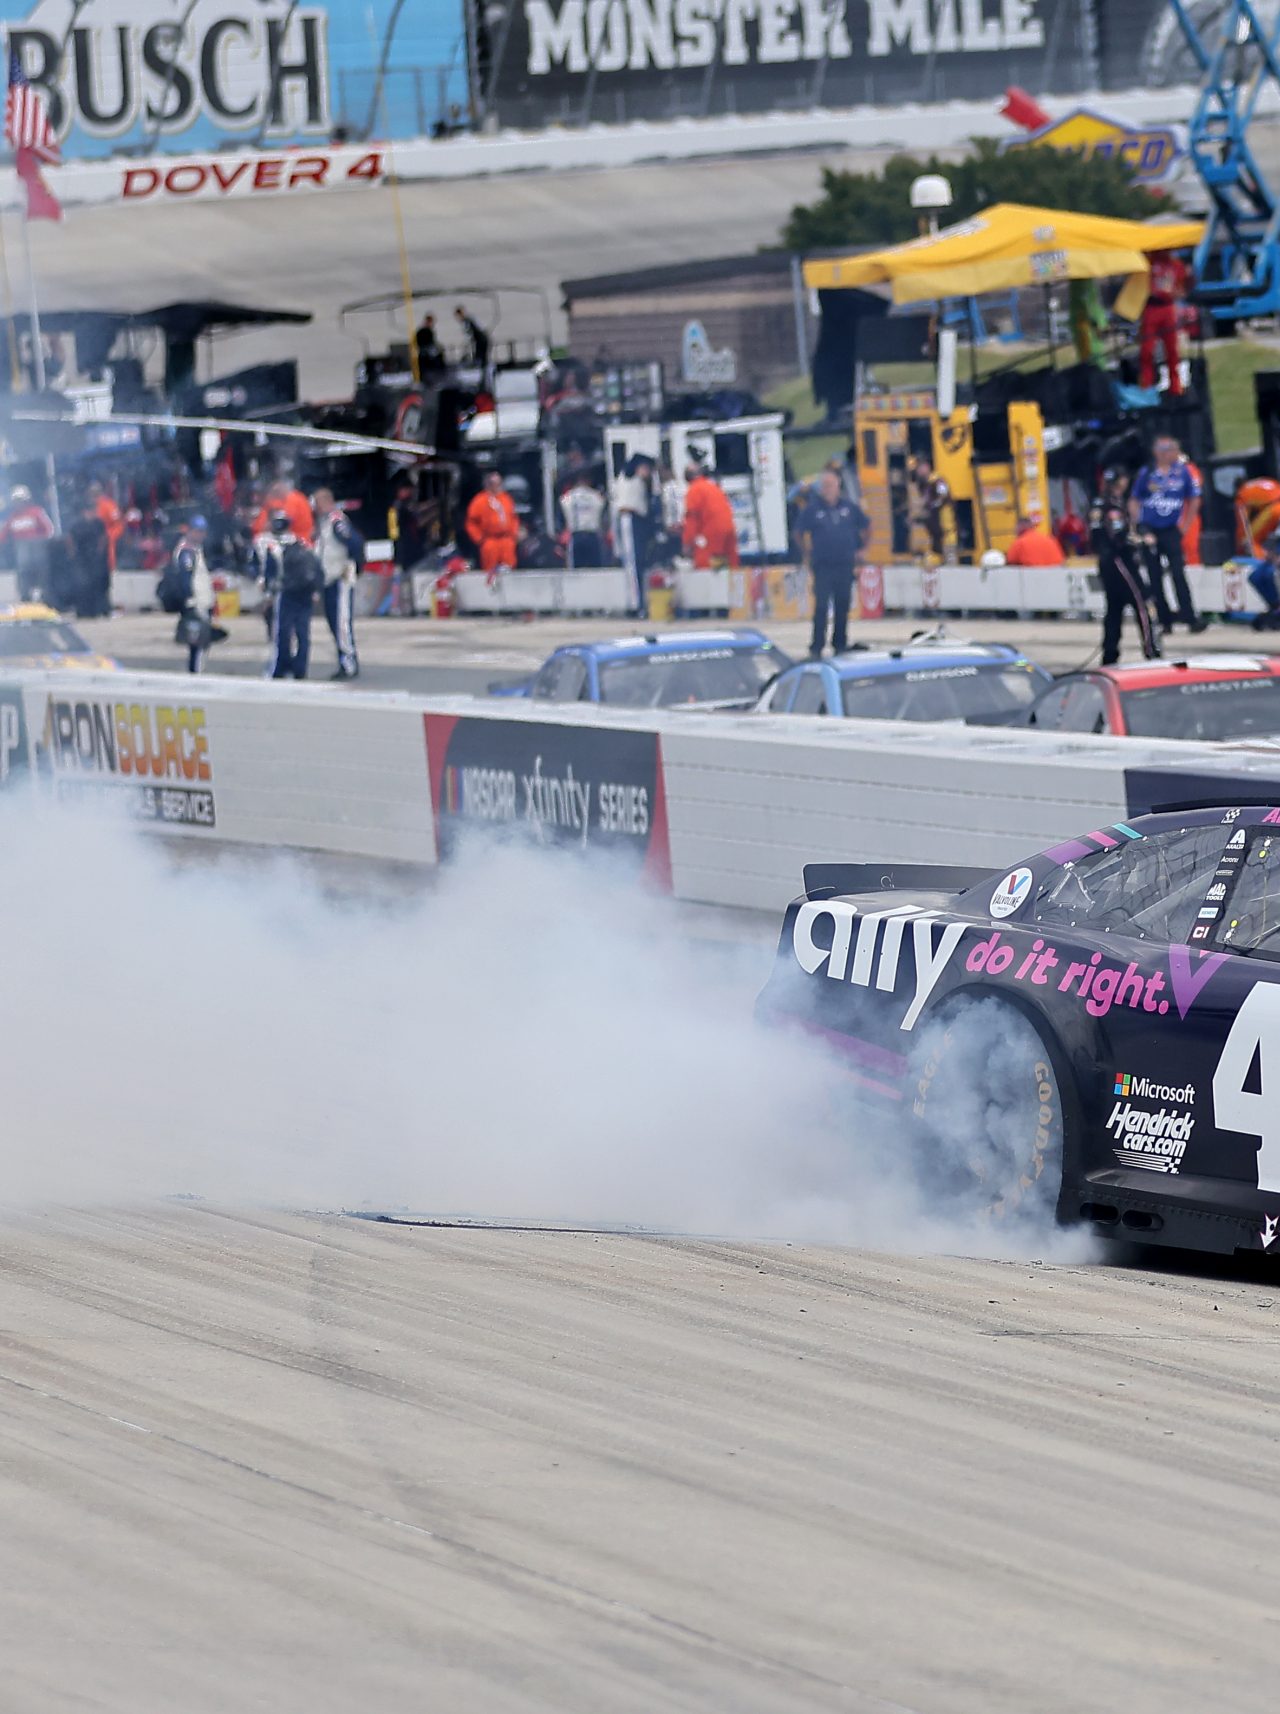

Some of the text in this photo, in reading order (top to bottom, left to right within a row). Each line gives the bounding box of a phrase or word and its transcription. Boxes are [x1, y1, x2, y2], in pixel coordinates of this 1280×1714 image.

[525, 0, 1045, 75] MONSTER MILE
[8, 14, 330, 138] BUSCH
[122, 152, 384, 198] DOVER 4
[521, 754, 591, 849] xfinity
[599, 782, 648, 834] SERIES
[792, 899, 970, 1031] ally
[965, 932, 1169, 1017] do it right.
[1105, 1101, 1195, 1140] Hendrick
[1130, 1076, 1196, 1105] Microsoft
[1122, 1132, 1187, 1158] cars.com
